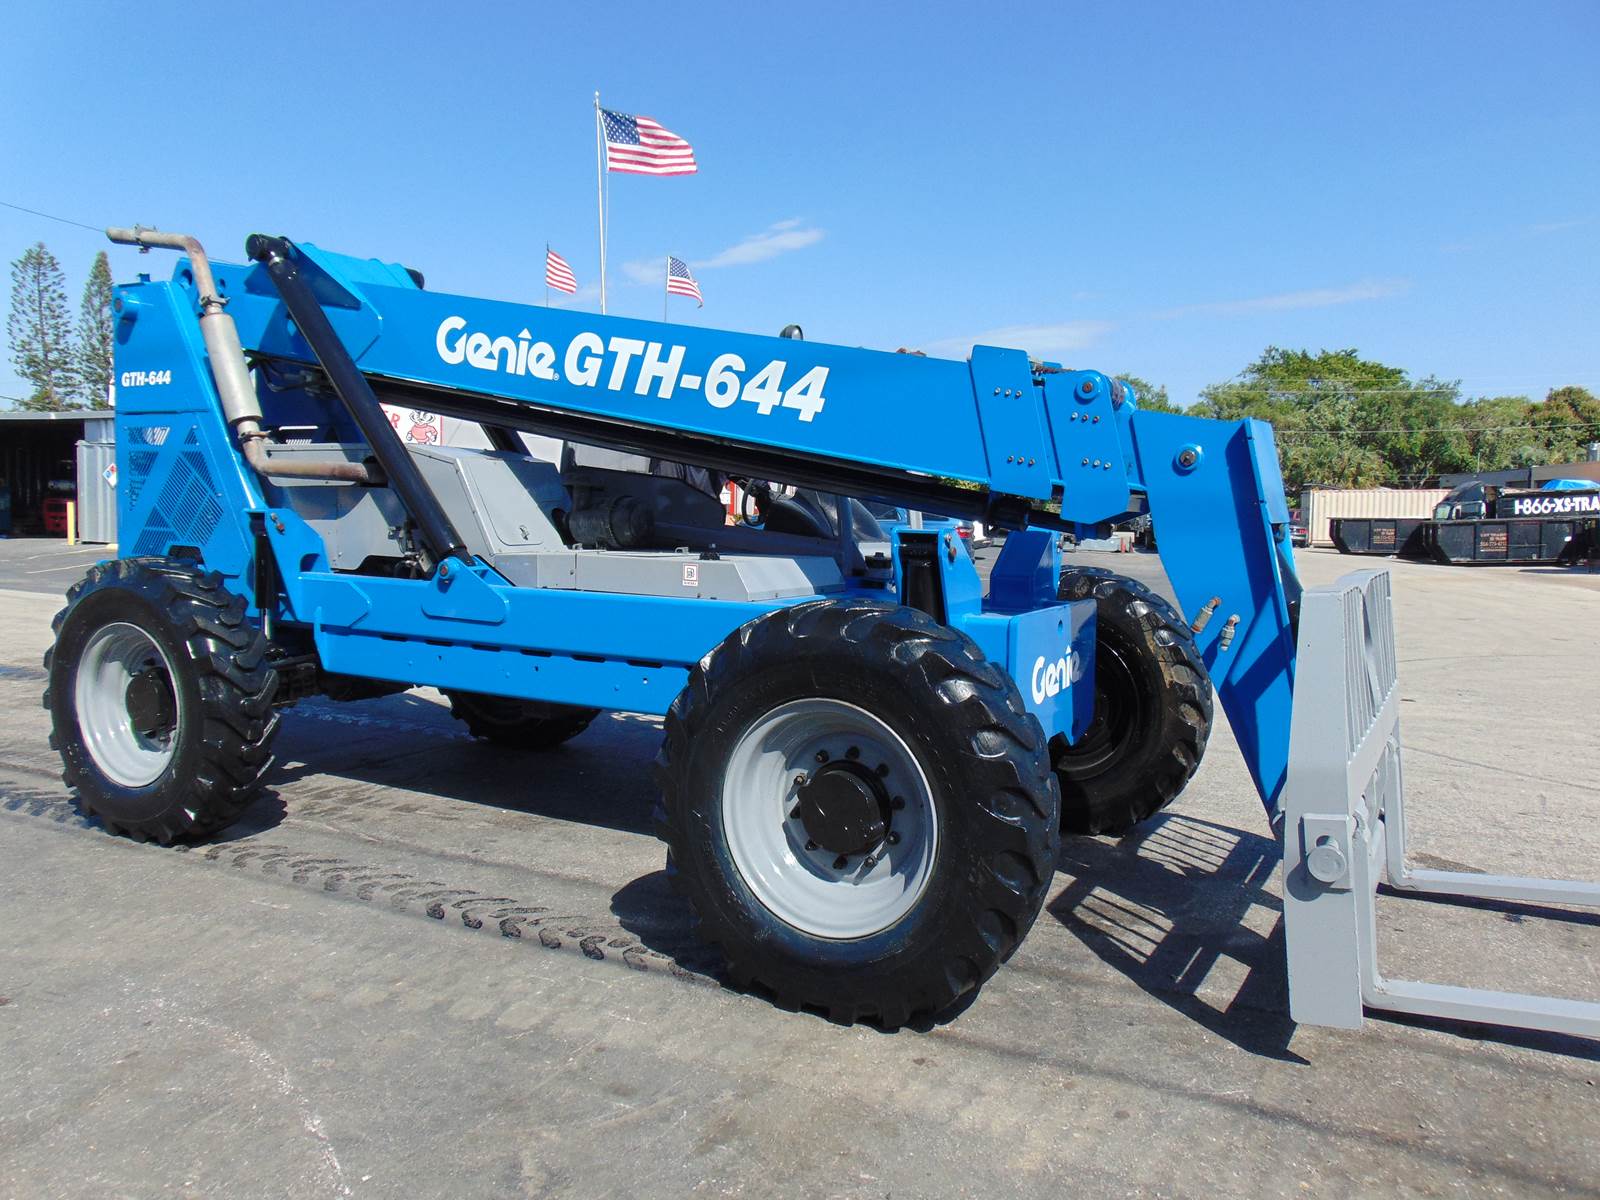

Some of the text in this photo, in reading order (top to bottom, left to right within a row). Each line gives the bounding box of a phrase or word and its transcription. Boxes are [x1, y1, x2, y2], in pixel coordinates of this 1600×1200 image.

[121, 370, 172, 387] GTH-644
[436, 316, 830, 422] Genie GTH-644
[1031, 644, 1081, 704] Genie
